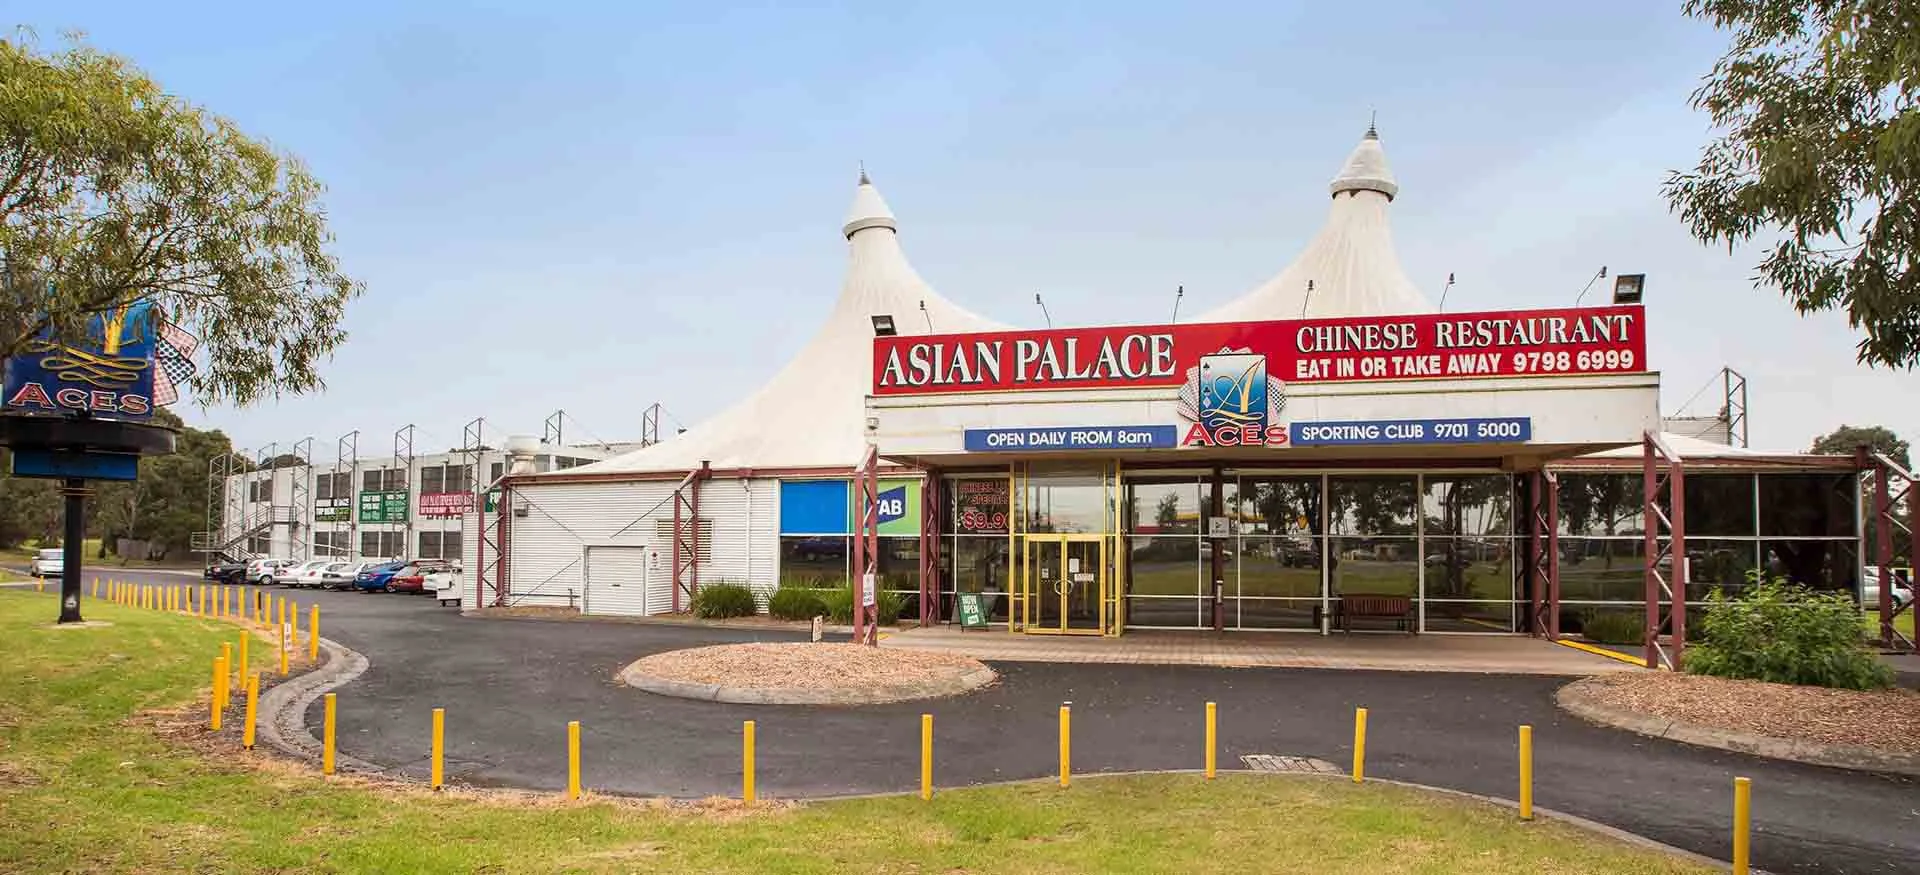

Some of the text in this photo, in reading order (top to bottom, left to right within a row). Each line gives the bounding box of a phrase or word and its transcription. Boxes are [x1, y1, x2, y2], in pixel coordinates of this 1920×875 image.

[1296, 315, 1634, 353] CHINESE RESTAURANT
[880, 334, 1177, 387] ASIAN PALACE
[1296, 349, 1635, 379] EAT IN OR TAKE AWAY 9798 6999
[8, 382, 149, 414] ACES
[986, 429, 1153, 447] OPEN DAILY FROM 8am
[1183, 421, 1289, 447] ACES
[1301, 421, 1521, 441] SPORTING CLUB 9701 5000
